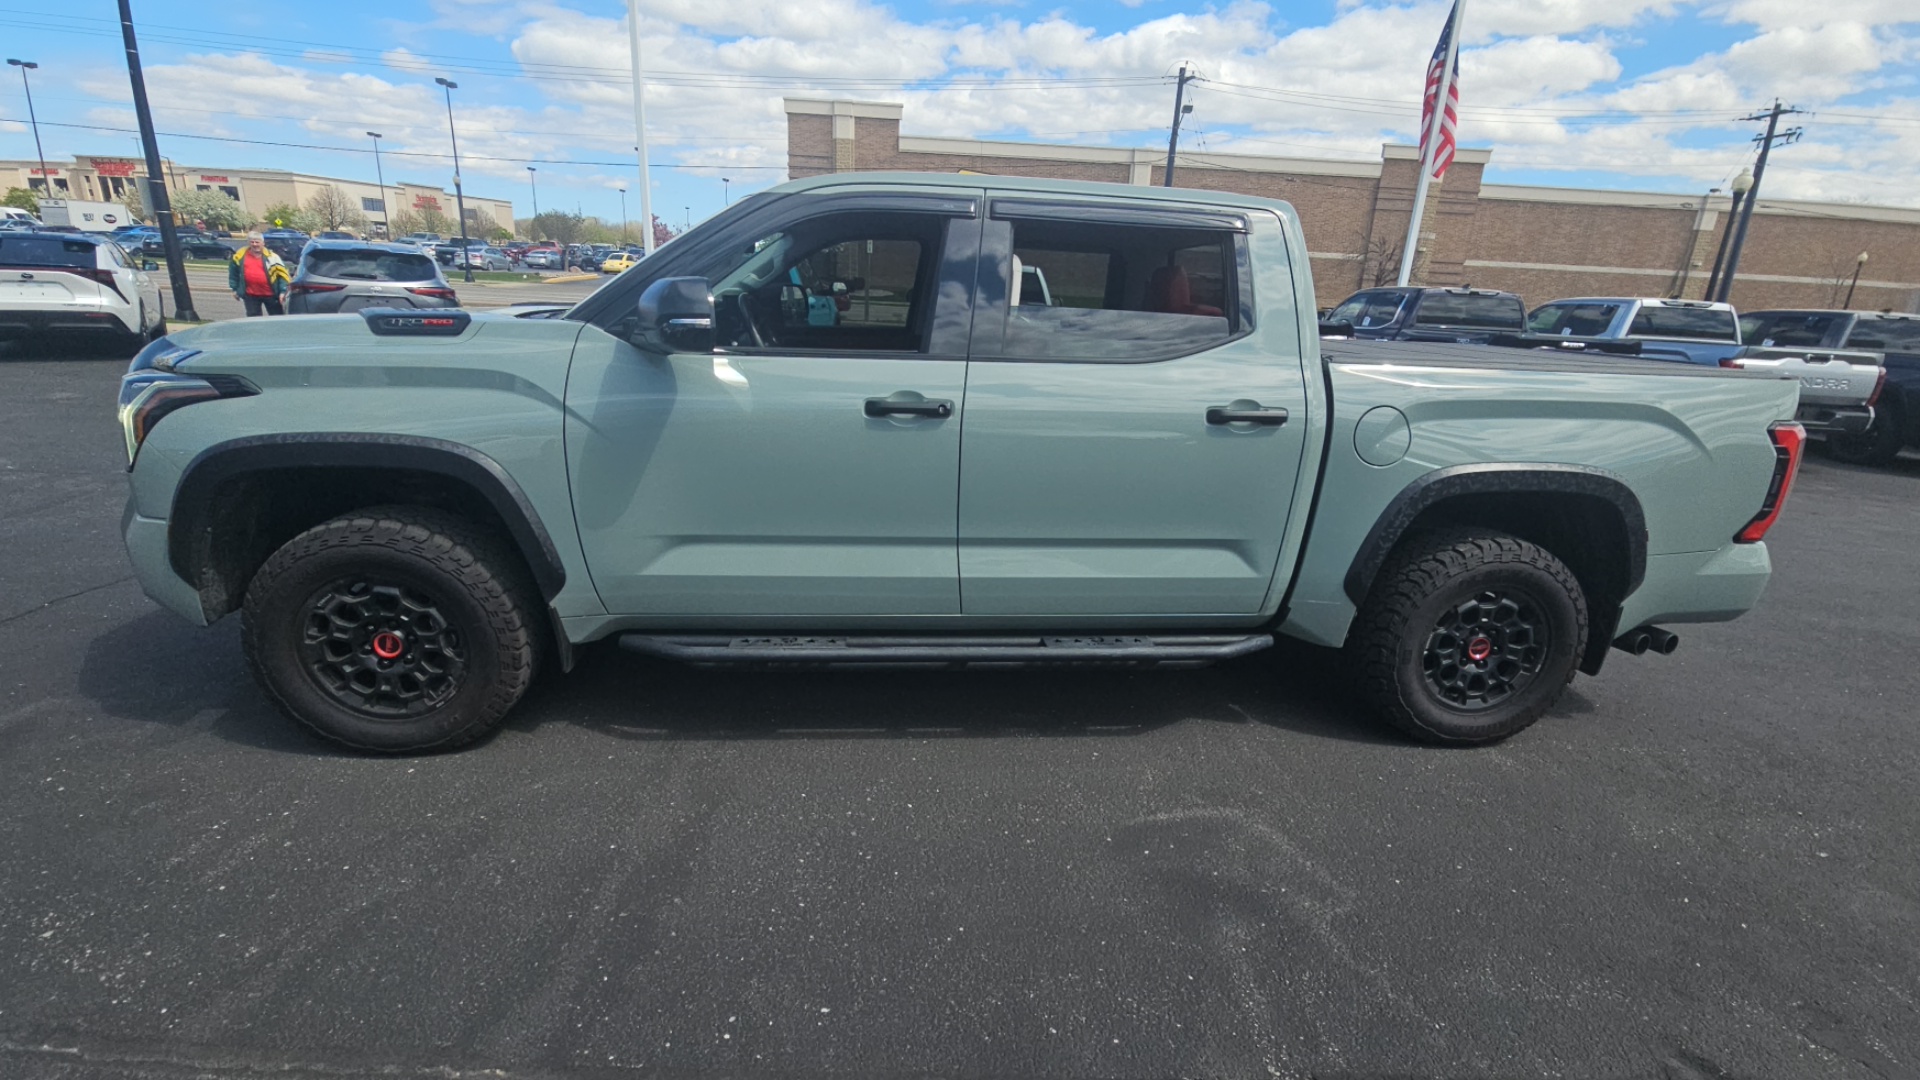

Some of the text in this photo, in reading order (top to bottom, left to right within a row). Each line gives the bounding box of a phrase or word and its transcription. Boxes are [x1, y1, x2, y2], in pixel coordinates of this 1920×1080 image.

[389, 317, 454, 327] TRD PRO
[1799, 376, 1849, 390] NDRA
